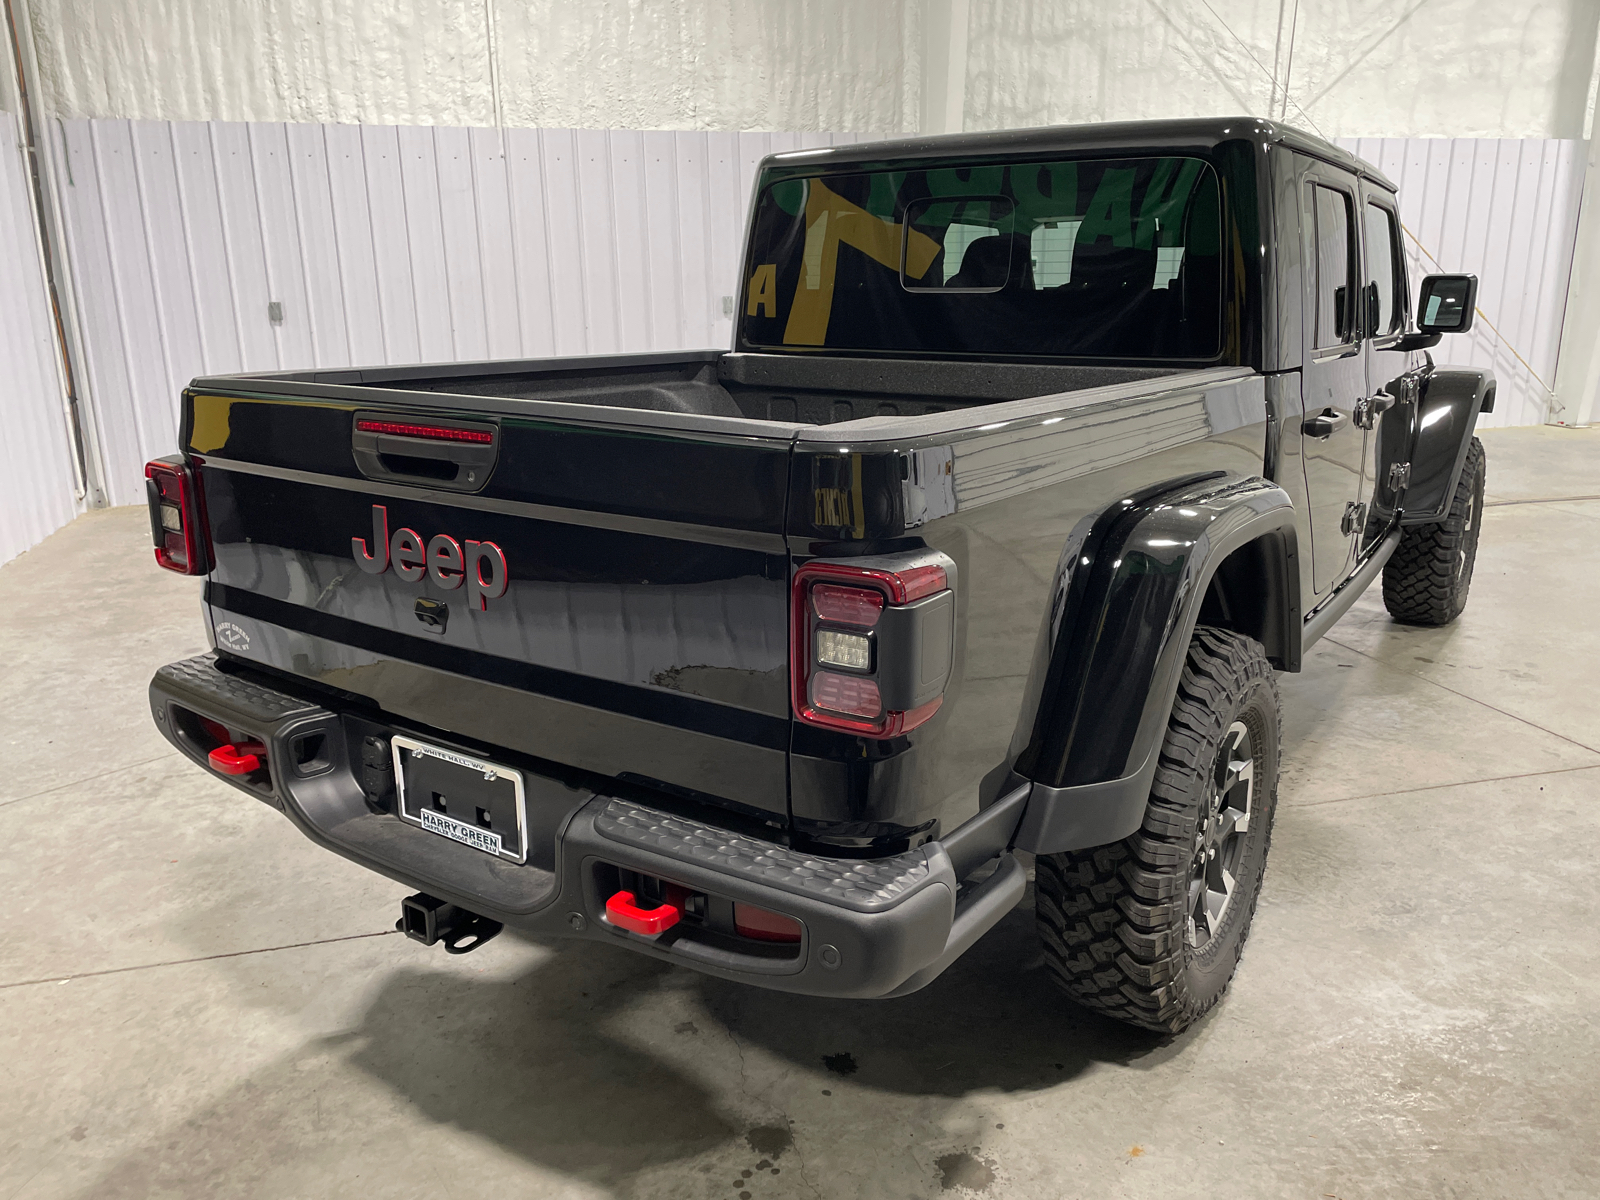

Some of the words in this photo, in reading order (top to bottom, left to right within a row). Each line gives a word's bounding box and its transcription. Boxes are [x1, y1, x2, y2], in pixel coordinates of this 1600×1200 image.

[351, 504, 508, 612] Jeep
[216, 622, 231, 633] HARRY
[231, 623, 250, 643] GREEN
[423, 748, 446, 758] WHITE
[471, 762, 484, 770] WV
[423, 813, 458, 833] HARRY
[460, 827, 498, 847] GREEN
[423, 822, 449, 836] CHRYSLER
[450, 832, 468, 844] DODGE
[470, 839, 483, 849] JEEP
[486, 844, 498, 854] RAM
